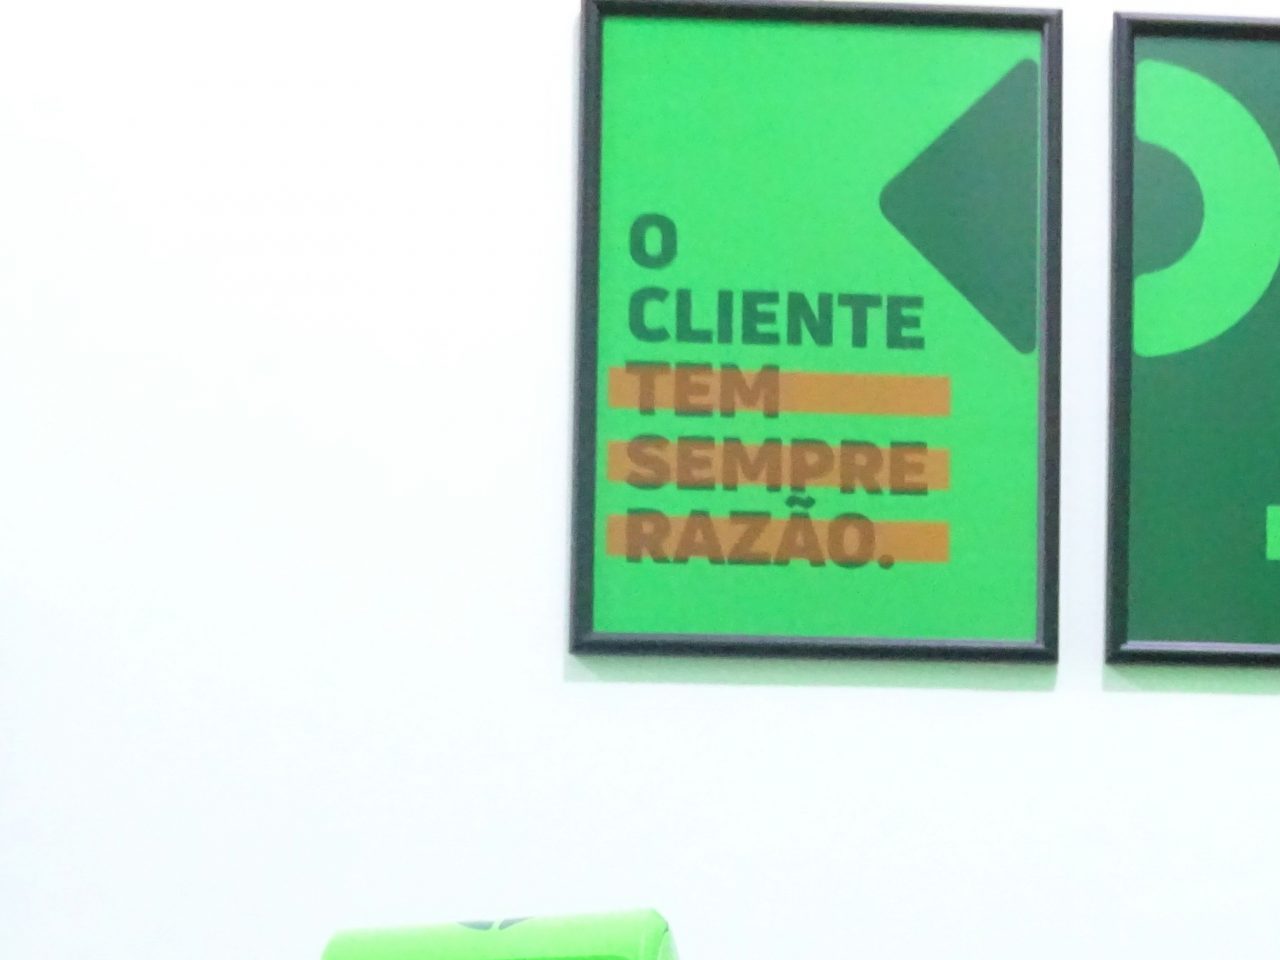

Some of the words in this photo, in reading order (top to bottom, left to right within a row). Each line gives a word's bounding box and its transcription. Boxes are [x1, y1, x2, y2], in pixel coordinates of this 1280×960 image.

[629, 212, 678, 269] O
[628, 286, 925, 350] CLIENTE
[625, 360, 780, 418] TEM
[625, 434, 929, 496] SEMPRE
[624, 495, 895, 570] RAZÃO.
